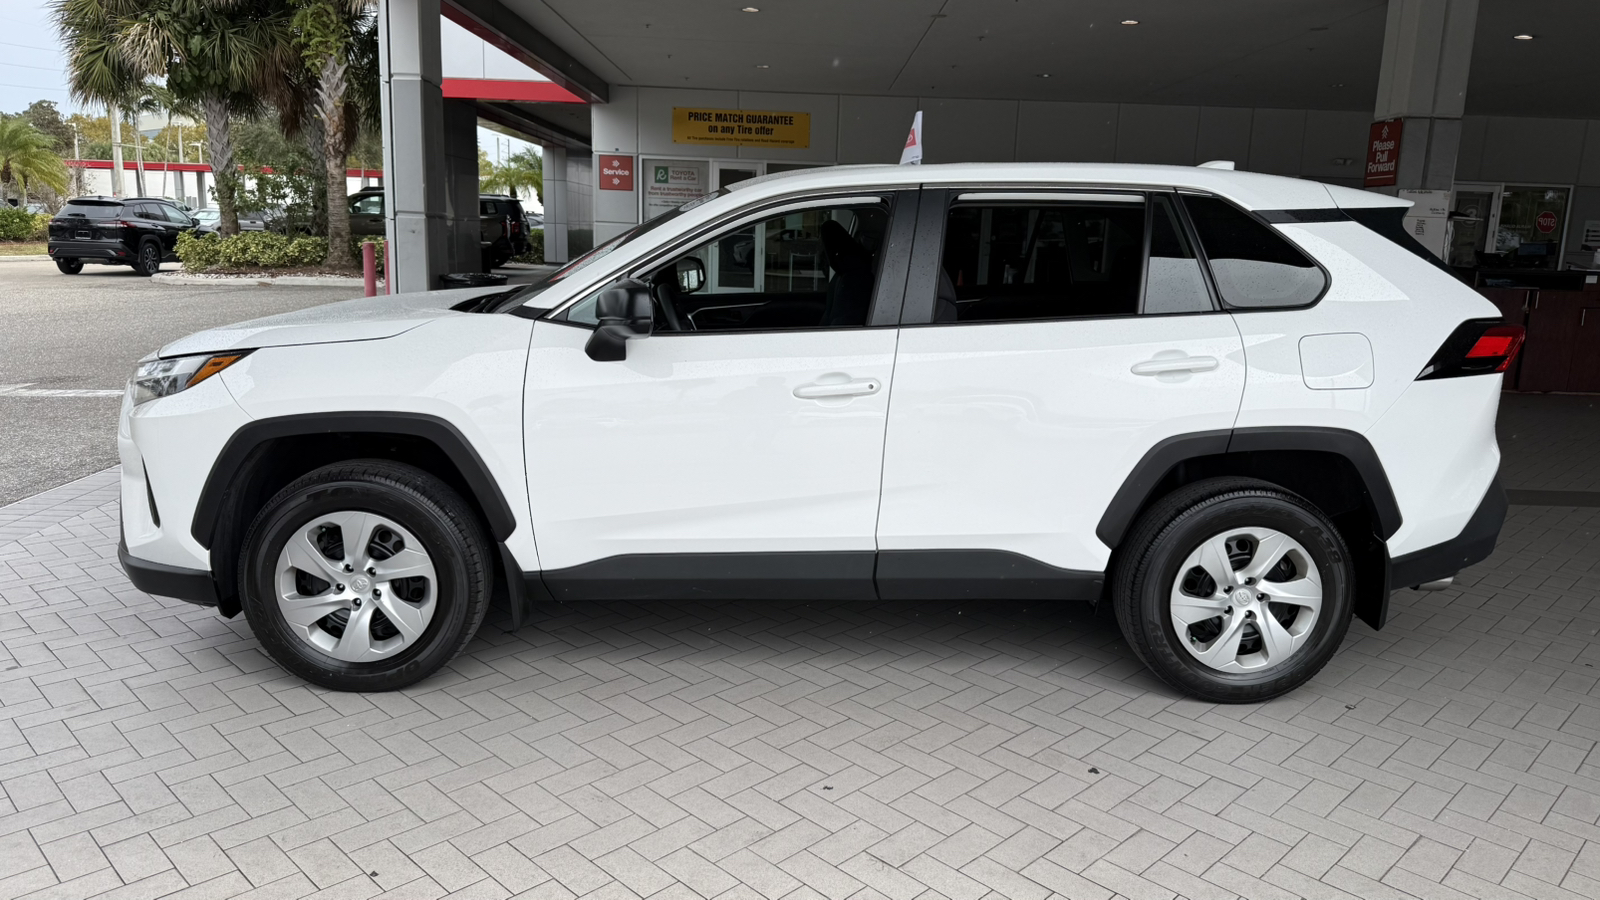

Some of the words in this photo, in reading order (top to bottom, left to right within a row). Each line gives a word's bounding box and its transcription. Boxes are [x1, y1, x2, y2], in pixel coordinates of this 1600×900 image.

[688, 112, 712, 122] PRICE
[714, 113, 744, 124] MATCH
[746, 114, 794, 126] GUARANTEE
[708, 125, 718, 134] on
[720, 126, 735, 135] any
[737, 124, 752, 134] Tire
[754, 126, 774, 136] offer
[1372, 140, 1394, 152] Please
[1376, 151, 1388, 162] Pull
[603, 168, 630, 176] Service
[1368, 160, 1396, 173] Forward
